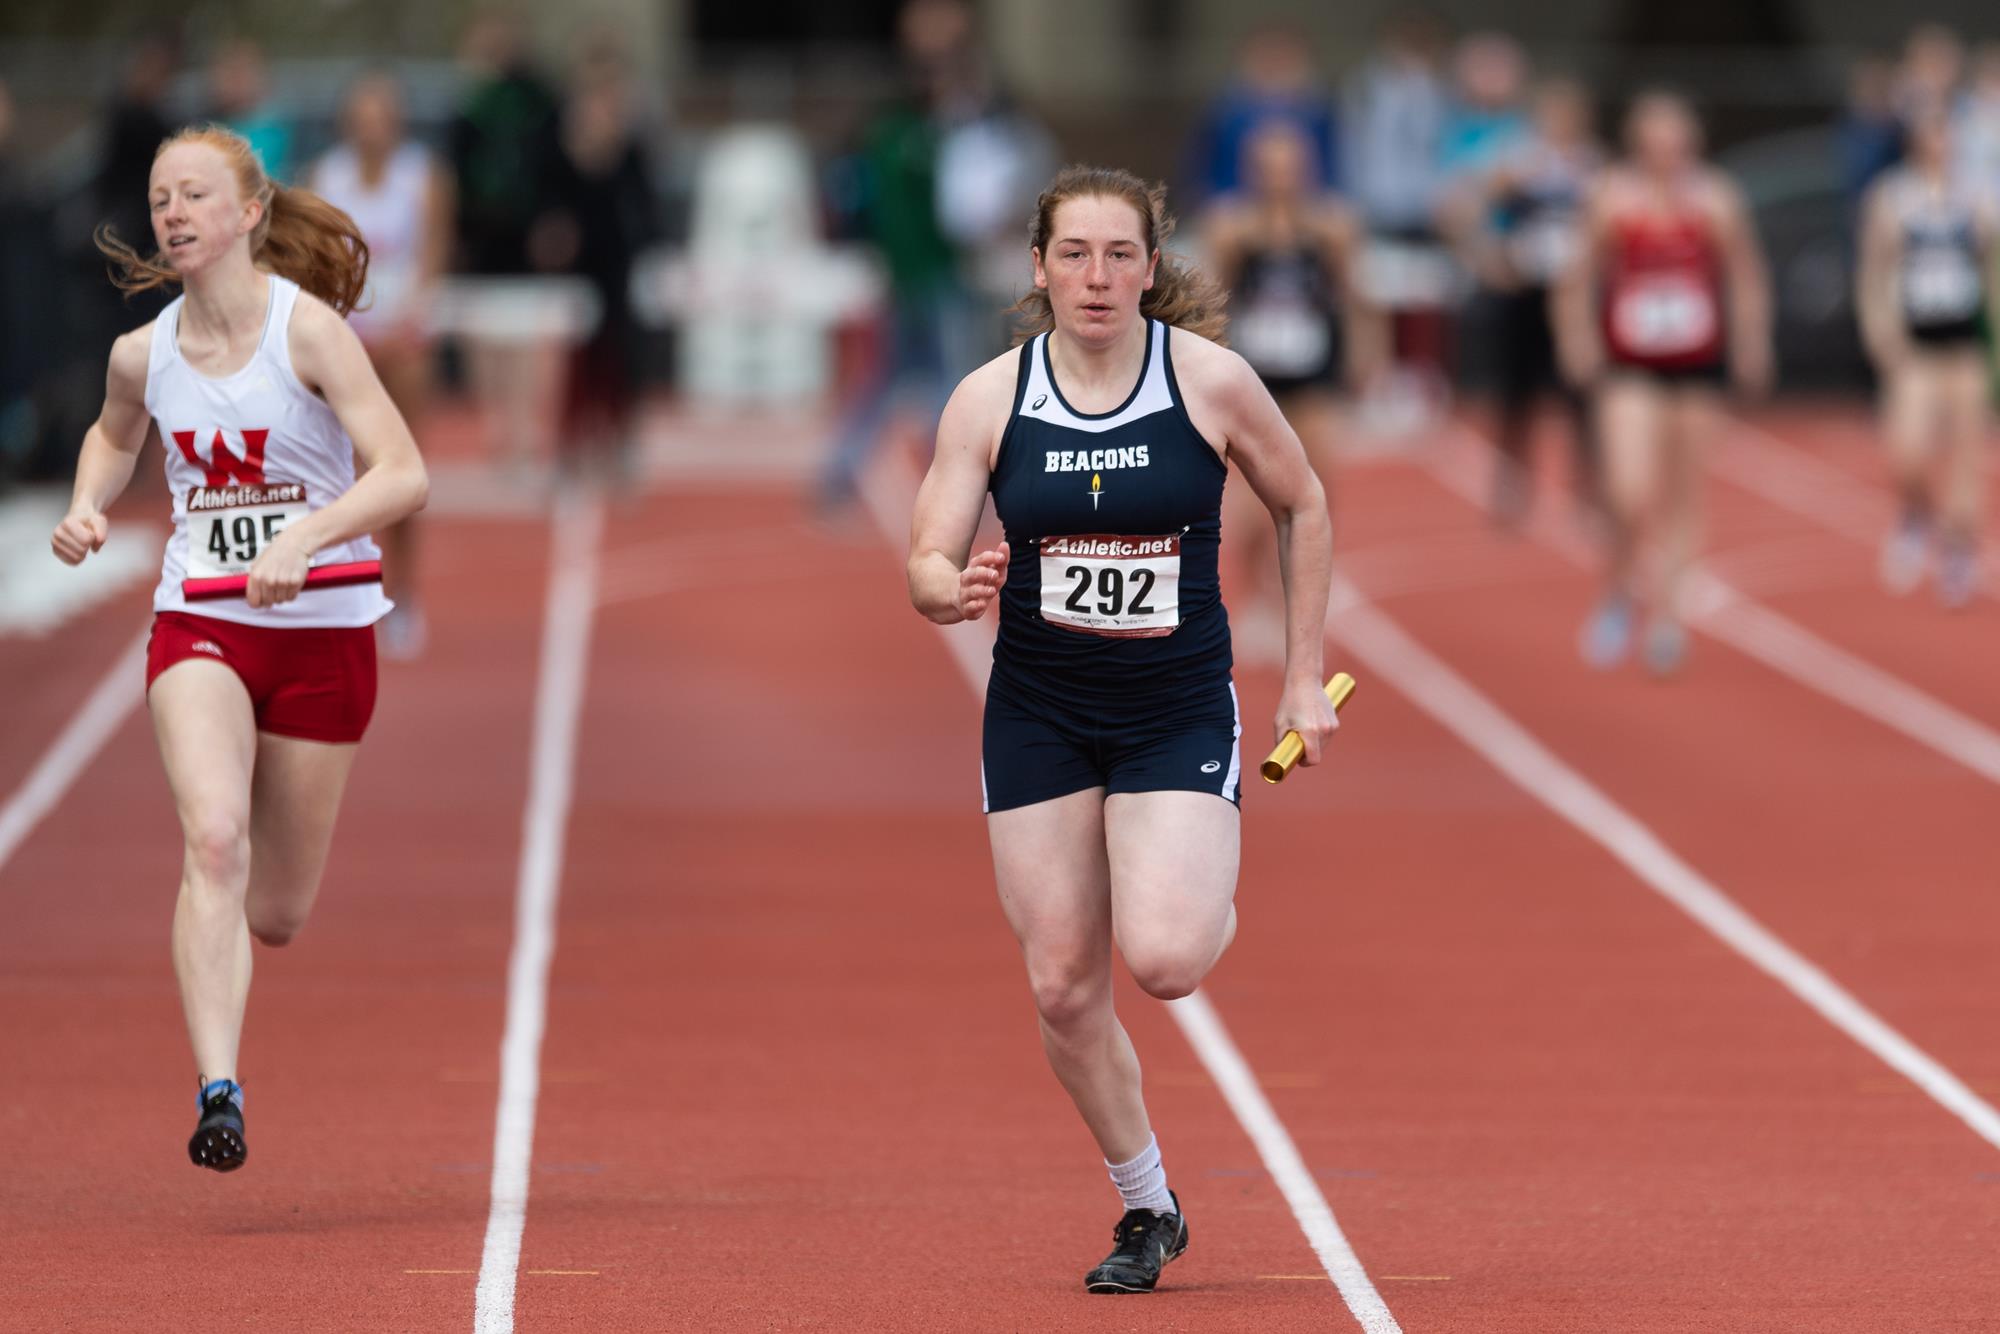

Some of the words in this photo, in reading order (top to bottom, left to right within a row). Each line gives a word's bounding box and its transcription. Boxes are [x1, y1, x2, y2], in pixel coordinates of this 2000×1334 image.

[171, 427, 270, 486] W
[1044, 445, 1150, 473] BEACONS
[189, 484, 302, 510] Athletic.net
[1046, 536, 1173, 556] Athletic.net
[1065, 565, 1156, 616] 292
